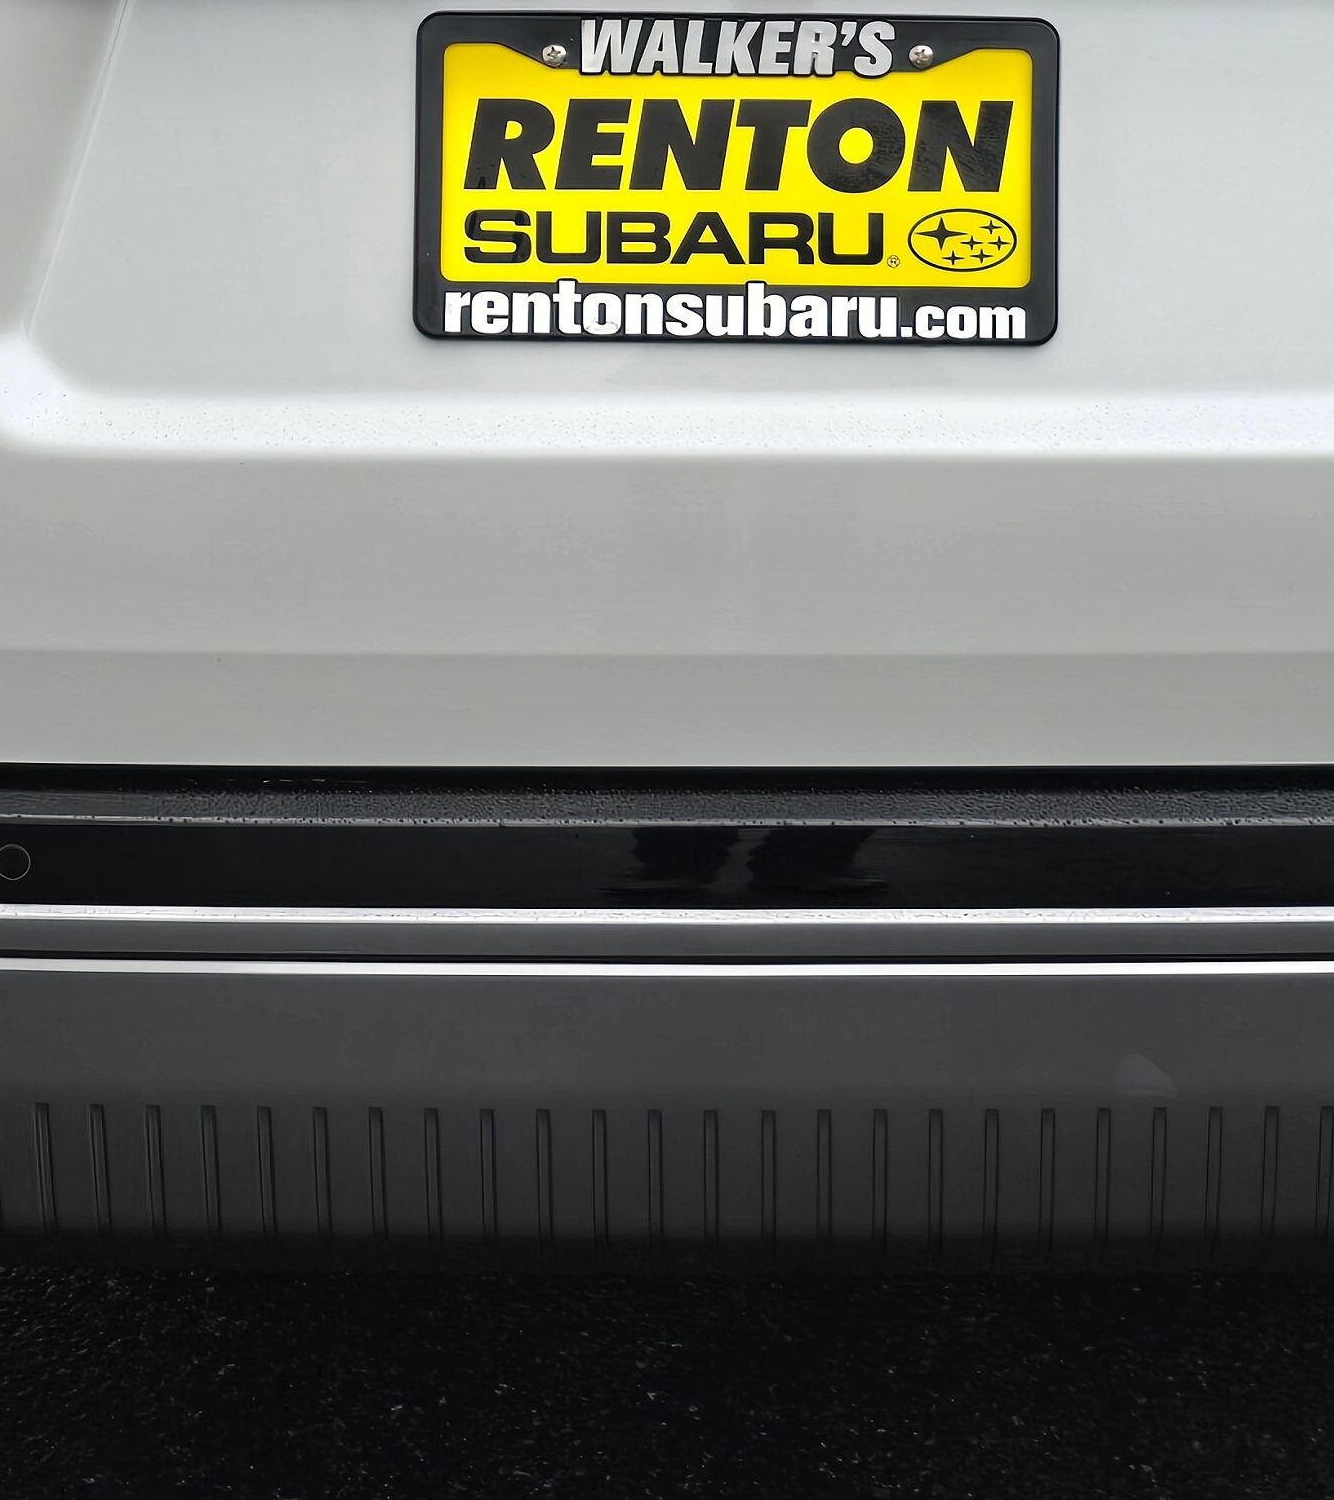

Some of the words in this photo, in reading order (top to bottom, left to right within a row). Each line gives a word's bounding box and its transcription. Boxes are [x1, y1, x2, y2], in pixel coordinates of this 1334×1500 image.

[580, 19, 896, 76] WALKER'S
[463, 98, 1014, 193] RENTON
[463, 210, 885, 265] SUBARU
[443, 280, 1027, 340] rentonsubaru.com
